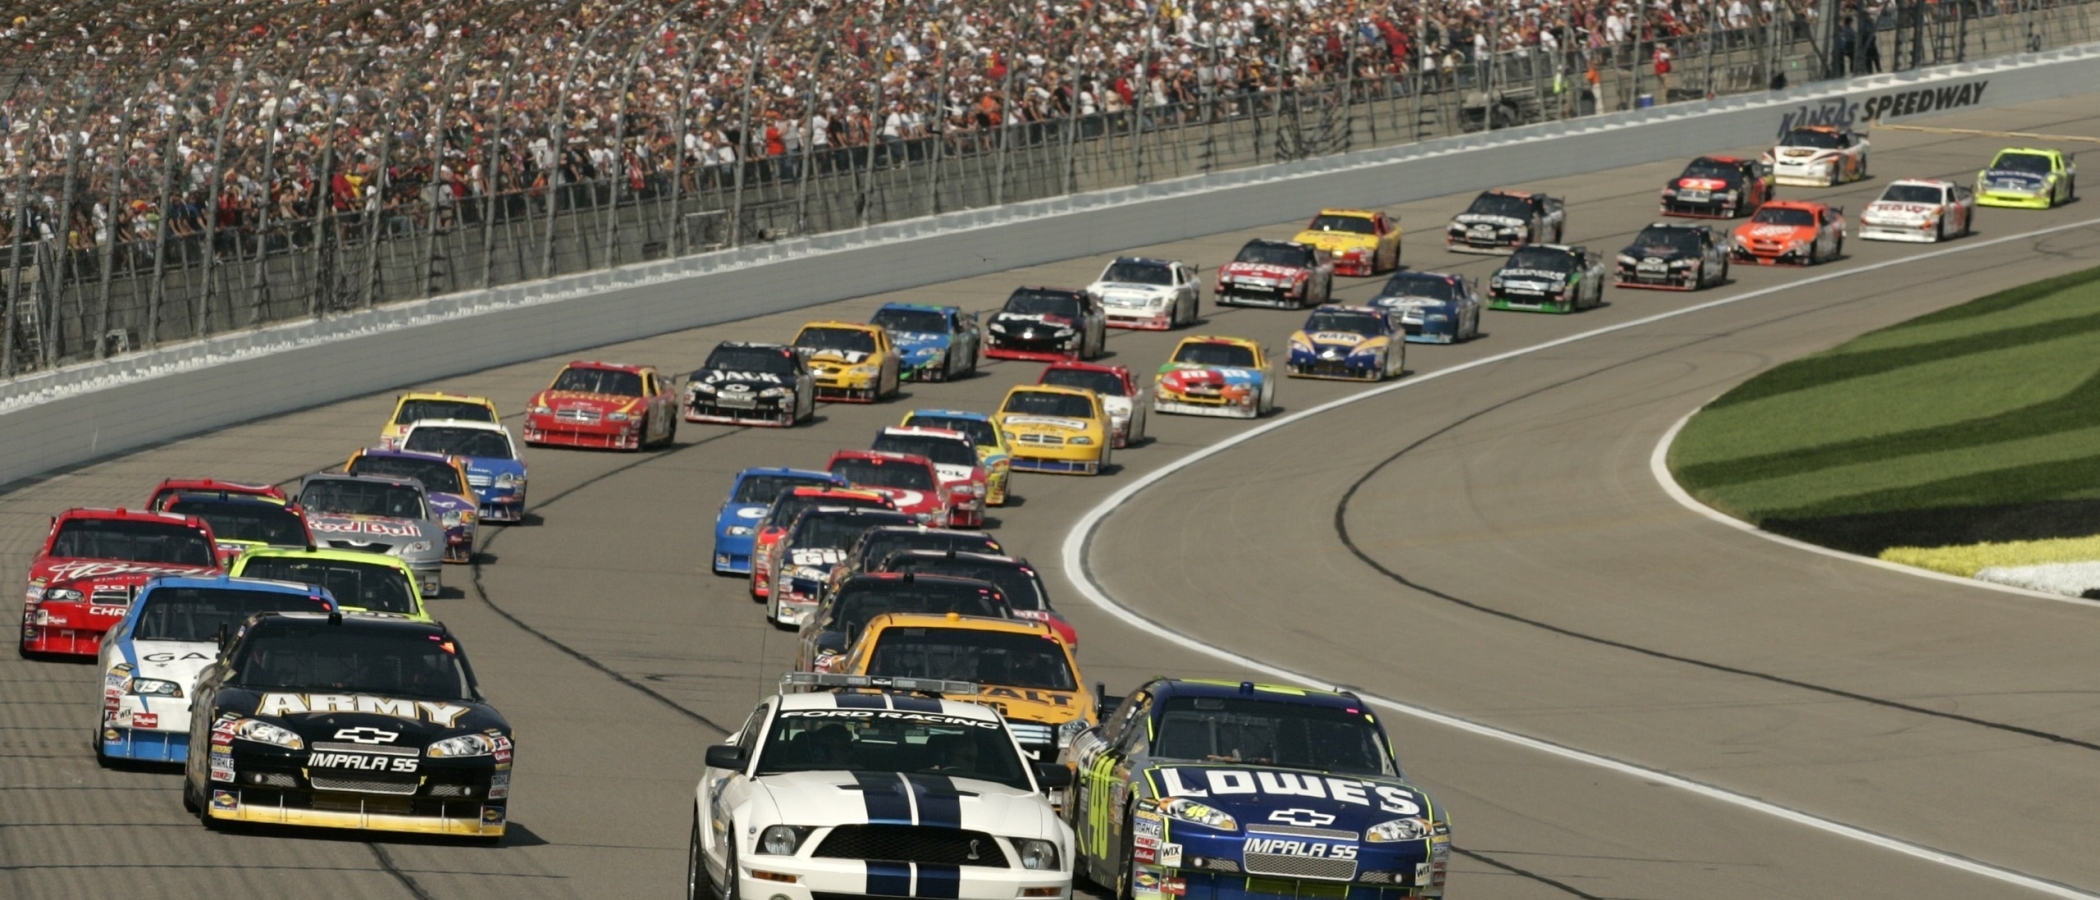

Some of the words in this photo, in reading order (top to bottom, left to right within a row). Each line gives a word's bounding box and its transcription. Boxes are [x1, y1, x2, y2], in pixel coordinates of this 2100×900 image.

[1778, 97, 1859, 138] KANSAS
[1861, 81, 1988, 122] SPEEDWAY
[1318, 333, 1357, 342] NAPA
[705, 370, 782, 384] JACK
[364, 521, 421, 538] Bull
[140, 680, 165, 693] 19
[255, 693, 470, 728] ARMY
[780, 711, 874, 719] FORD
[878, 712, 1000, 730] RACING
[307, 752, 388, 771] IMPALA
[390, 757, 419, 773] SS
[1160, 768, 1420, 816] LOWE'S
[1135, 822, 1161, 836] MAHLE
[1162, 846, 1180, 858] WIX
[1243, 838, 1329, 858] IMPALA
[1329, 844, 1359, 860] SS
[1417, 864, 1431, 878] WIX
